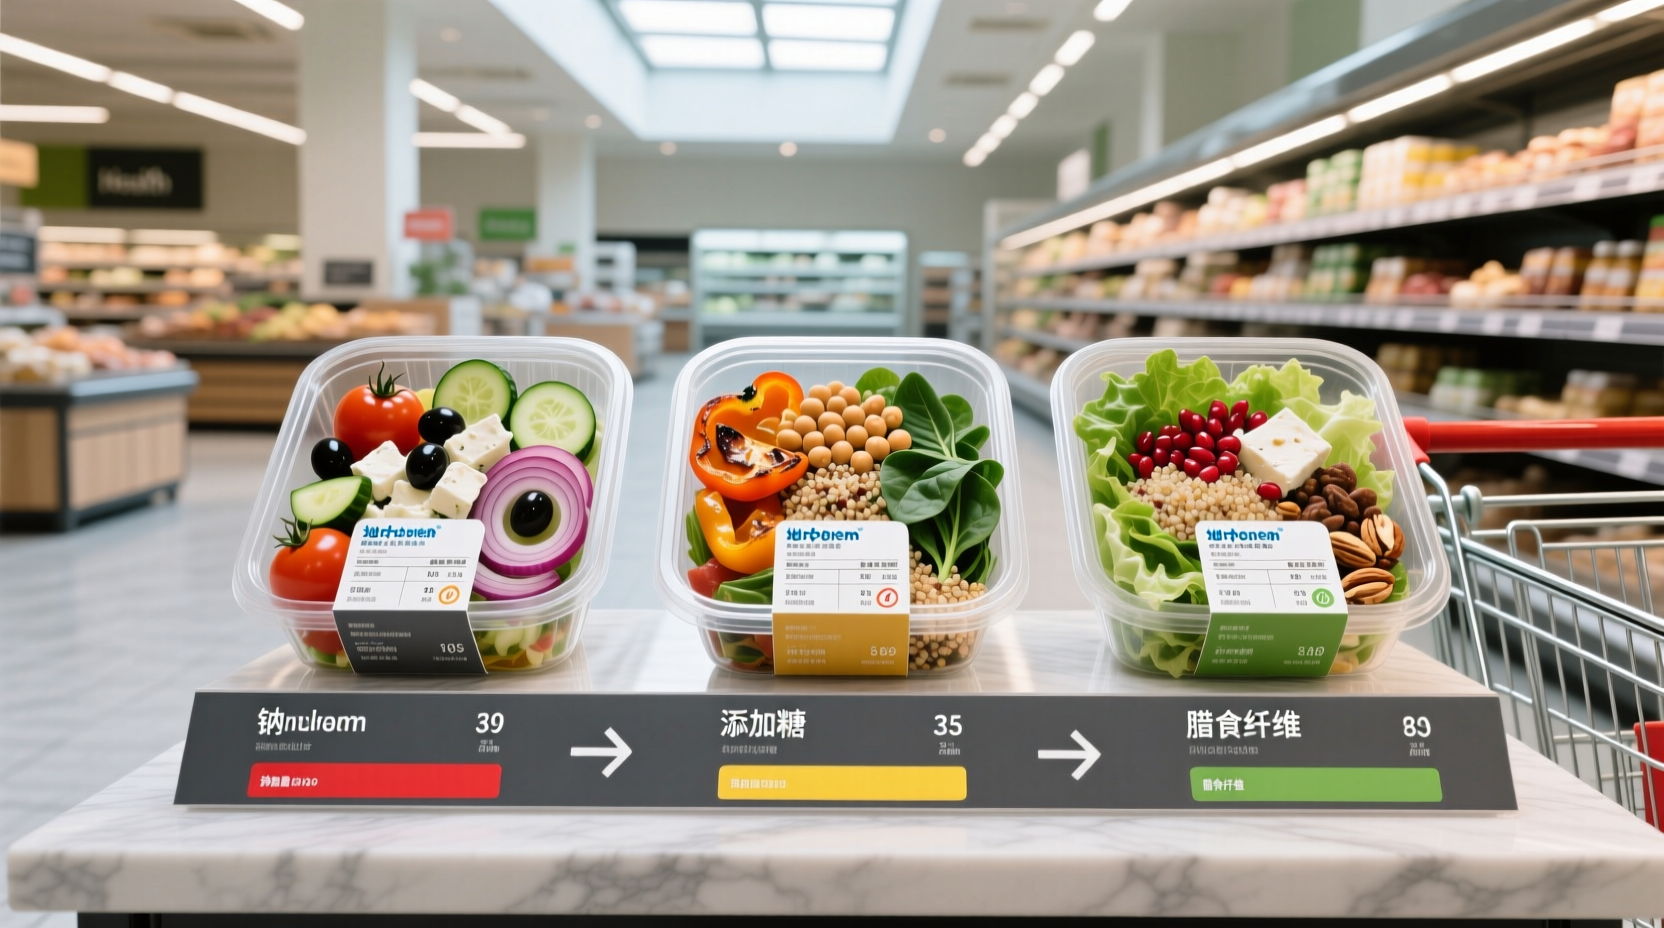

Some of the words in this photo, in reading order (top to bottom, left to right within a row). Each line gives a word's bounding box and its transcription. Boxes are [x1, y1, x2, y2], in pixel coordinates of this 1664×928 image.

[475, 712, 504, 734] 39
[720, 708, 806, 739] 添加糖
[933, 714, 963, 736] 35
[1186, 709, 1302, 739] 腊食纤维
[1402, 715, 1431, 738] 89
